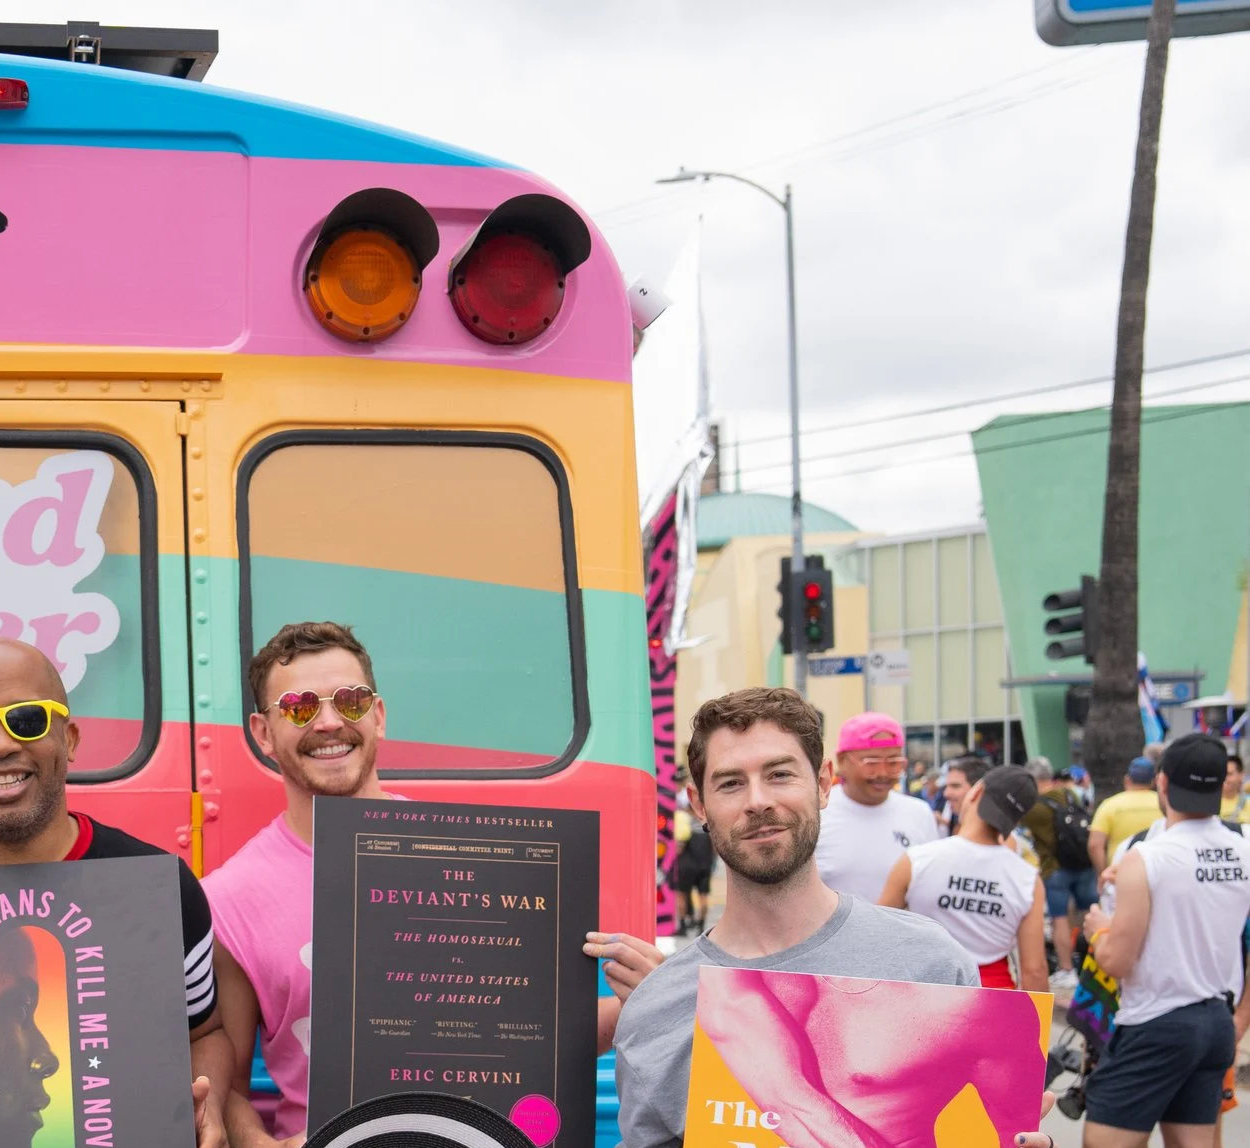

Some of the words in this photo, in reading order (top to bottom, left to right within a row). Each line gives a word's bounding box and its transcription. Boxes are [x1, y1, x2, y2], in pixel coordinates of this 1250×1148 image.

[364, 810, 389, 820] NEW
[394, 813, 427, 822] YORK
[431, 814, 470, 824] TIMES
[475, 816, 554, 828] BESTSELLER
[1195, 848, 1240, 863] HERE.
[442, 869, 475, 881] THE
[1195, 867, 1248, 882] QUEER.
[948, 875, 1004, 897] HERE.
[369, 888, 491, 908] DEVIANT'S
[500, 894, 547, 911] WAR
[938, 894, 1006, 918] QUEER.
[56, 903, 93, 939] TO
[394, 932, 422, 942] THE
[427, 934, 523, 947] HOMOSEXUAL
[74, 945, 107, 1005] KILL
[386, 972, 414, 982] THE
[420, 973, 474, 984] UNITED
[479, 975, 529, 986] STATES
[414, 993, 432, 1002] OF
[437, 994, 502, 1005] AMERICA
[78, 1013, 109, 1051] ME
[82, 1075, 110, 1091] A
[390, 1068, 434, 1082] ERIC
[442, 1070, 523, 1084] CERVINI
[705, 1099, 782, 1131] The
